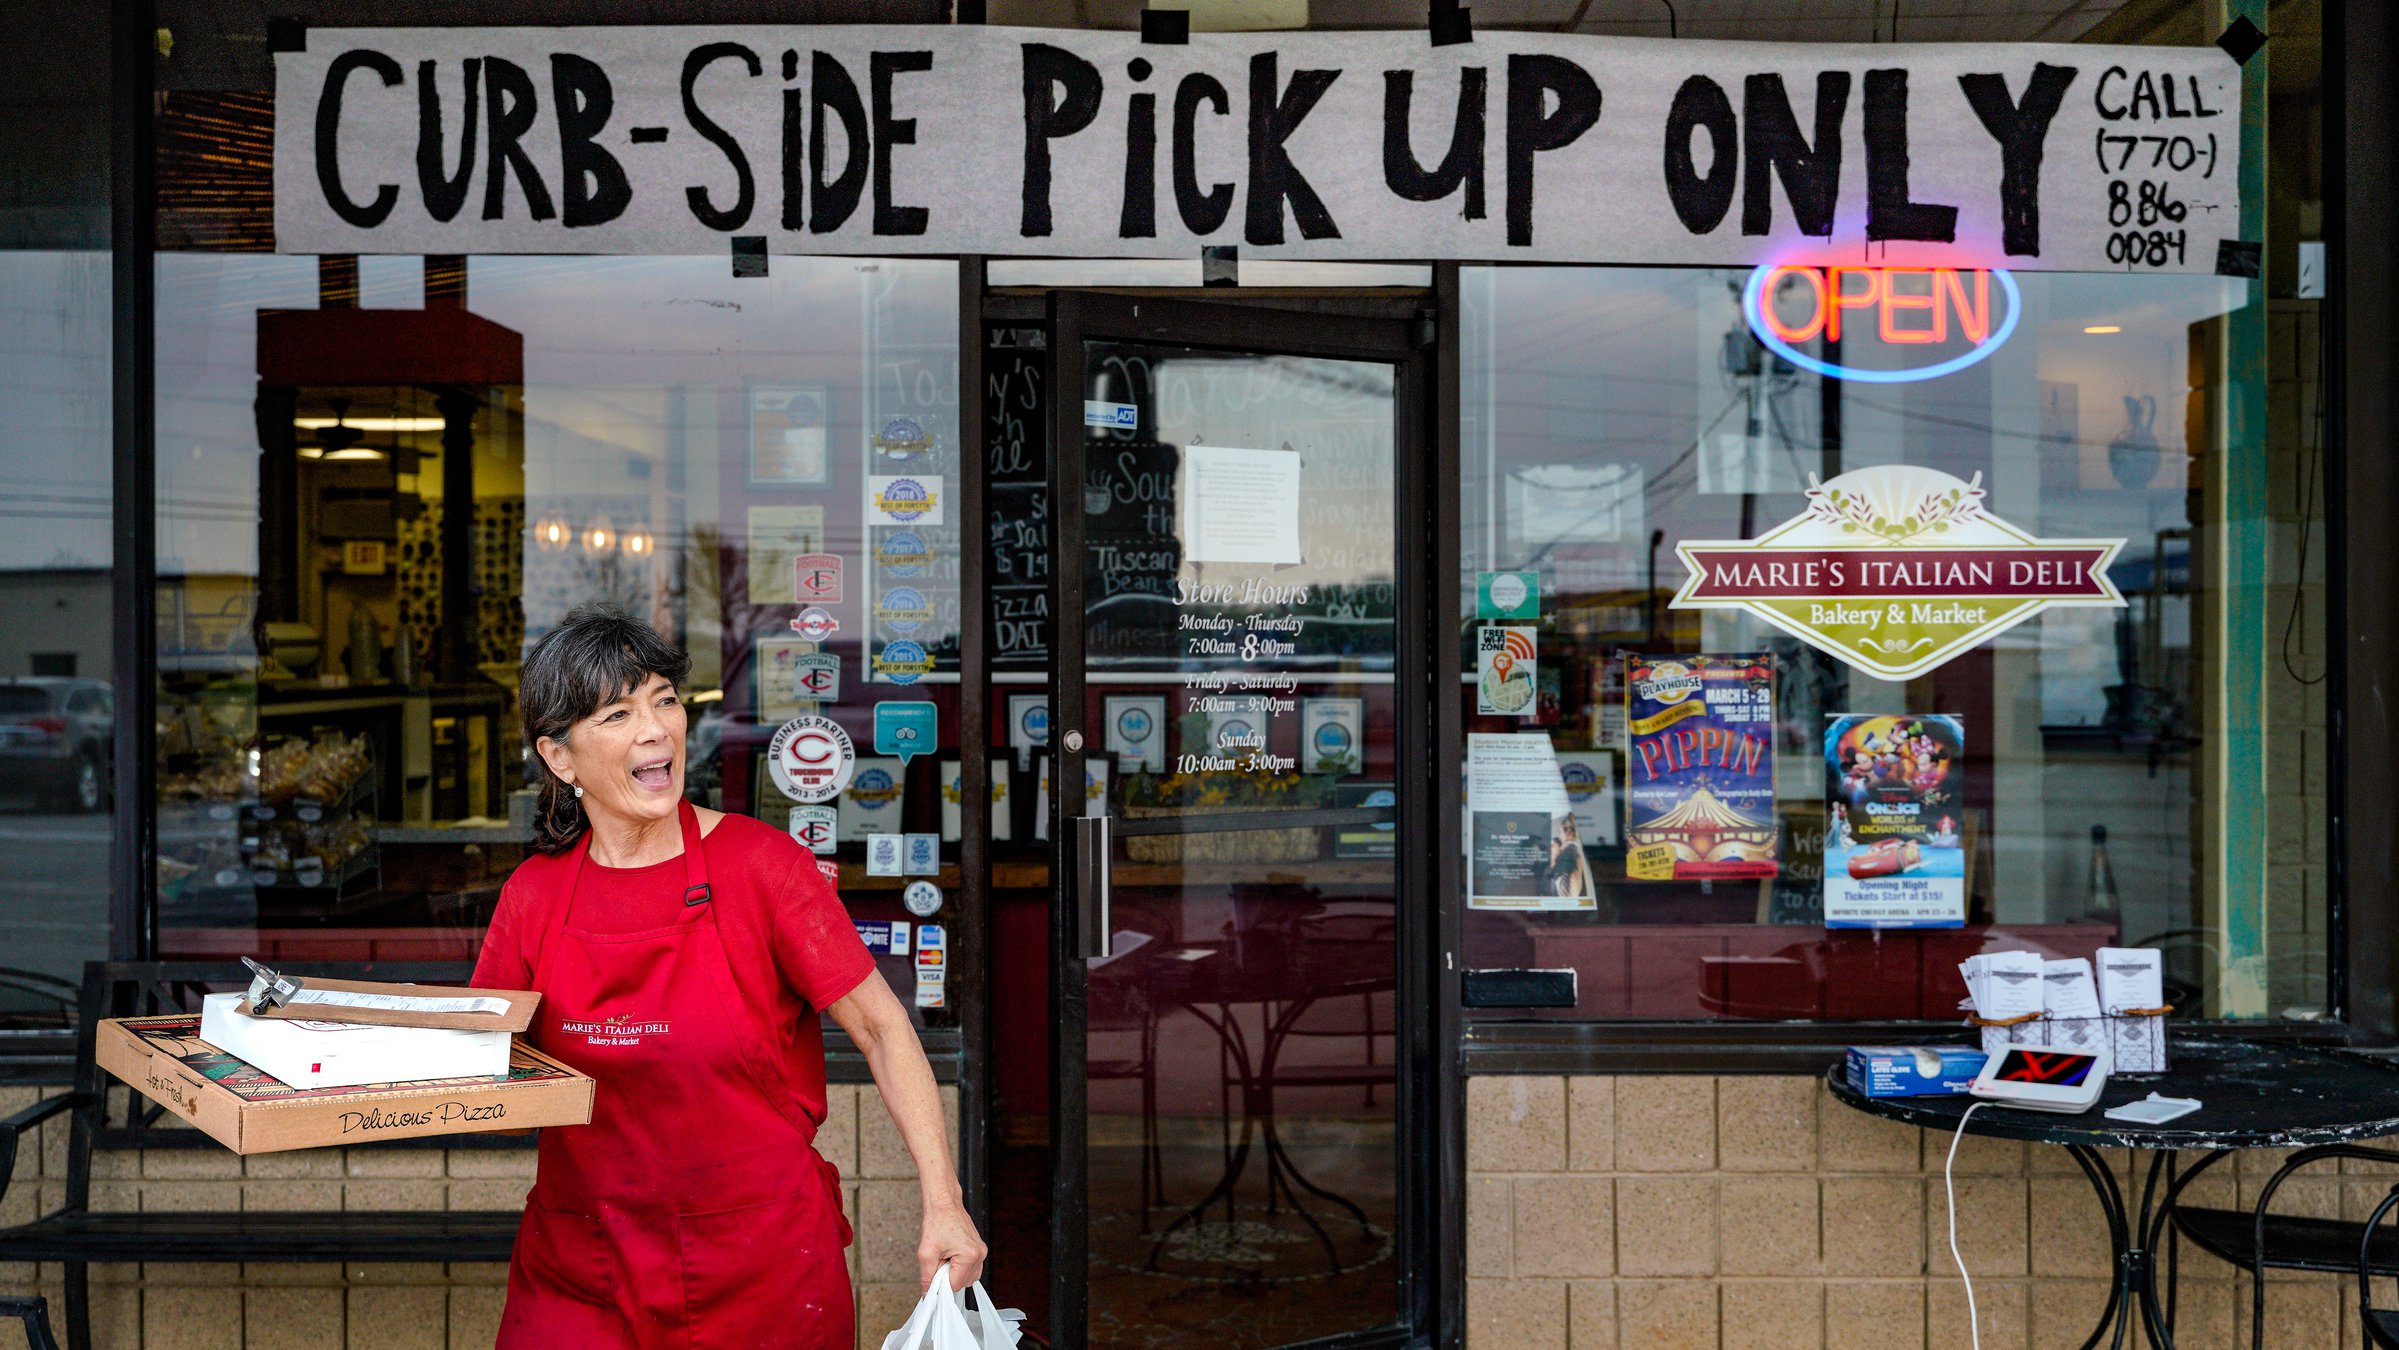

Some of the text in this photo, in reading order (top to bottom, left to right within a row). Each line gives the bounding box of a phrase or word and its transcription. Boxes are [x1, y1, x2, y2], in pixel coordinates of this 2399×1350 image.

[1664, 62, 2077, 257] ONLY
[2106, 229, 2186, 267] 0084
[1761, 266, 1989, 343] OPEN
[1118, 410, 1134, 422] ADT
[1713, 558, 2083, 587] MARIE'S ITALIAN DELI
[1172, 576, 1308, 606] Store Hours
[1179, 612, 1234, 635] Monday
[1245, 613, 1304, 636] Thursday
[1810, 603, 1987, 630] Bakery & Market
[1189, 638, 1236, 654] 7:00am
[1241, 634, 1295, 662] 8:00pm
[795, 658, 840, 669] FOOTBALL
[1186, 671, 1229, 694] Friday
[1240, 671, 1298, 694] Saturday
[1641, 675, 1701, 697] PLAYHOUSE
[1189, 697, 1236, 713] 7:00am
[1248, 697, 1295, 717] 9:00pm
[1705, 689, 1740, 704] MARCH
[1742, 689, 1749, 703] 5
[1757, 688, 1771, 704] 29
[771, 717, 852, 761] BUSINESS PARTNER
[1217, 729, 1266, 752] Sunday
[1176, 754, 1236, 774] 10:00am
[1245, 753, 1295, 774] 3:00pm
[1636, 727, 1768, 781] PIPPIN
[788, 785, 809, 798] 2013
[816, 784, 837, 798] 2014
[1858, 824, 1927, 834] ENCHANTMENT
[1870, 816, 1906, 824] WORLDS
[1637, 847, 1665, 860] TICKETS
[1844, 891, 1943, 901] Tickets Start at $15!
[1859, 880, 1928, 891] Opening Night
[562, 1023, 669, 1035] MARIE'S ITALIAN DELI
[588, 1036, 640, 1047] Bakery & Market
[338, 1101, 507, 1134] Delicious Pizza
